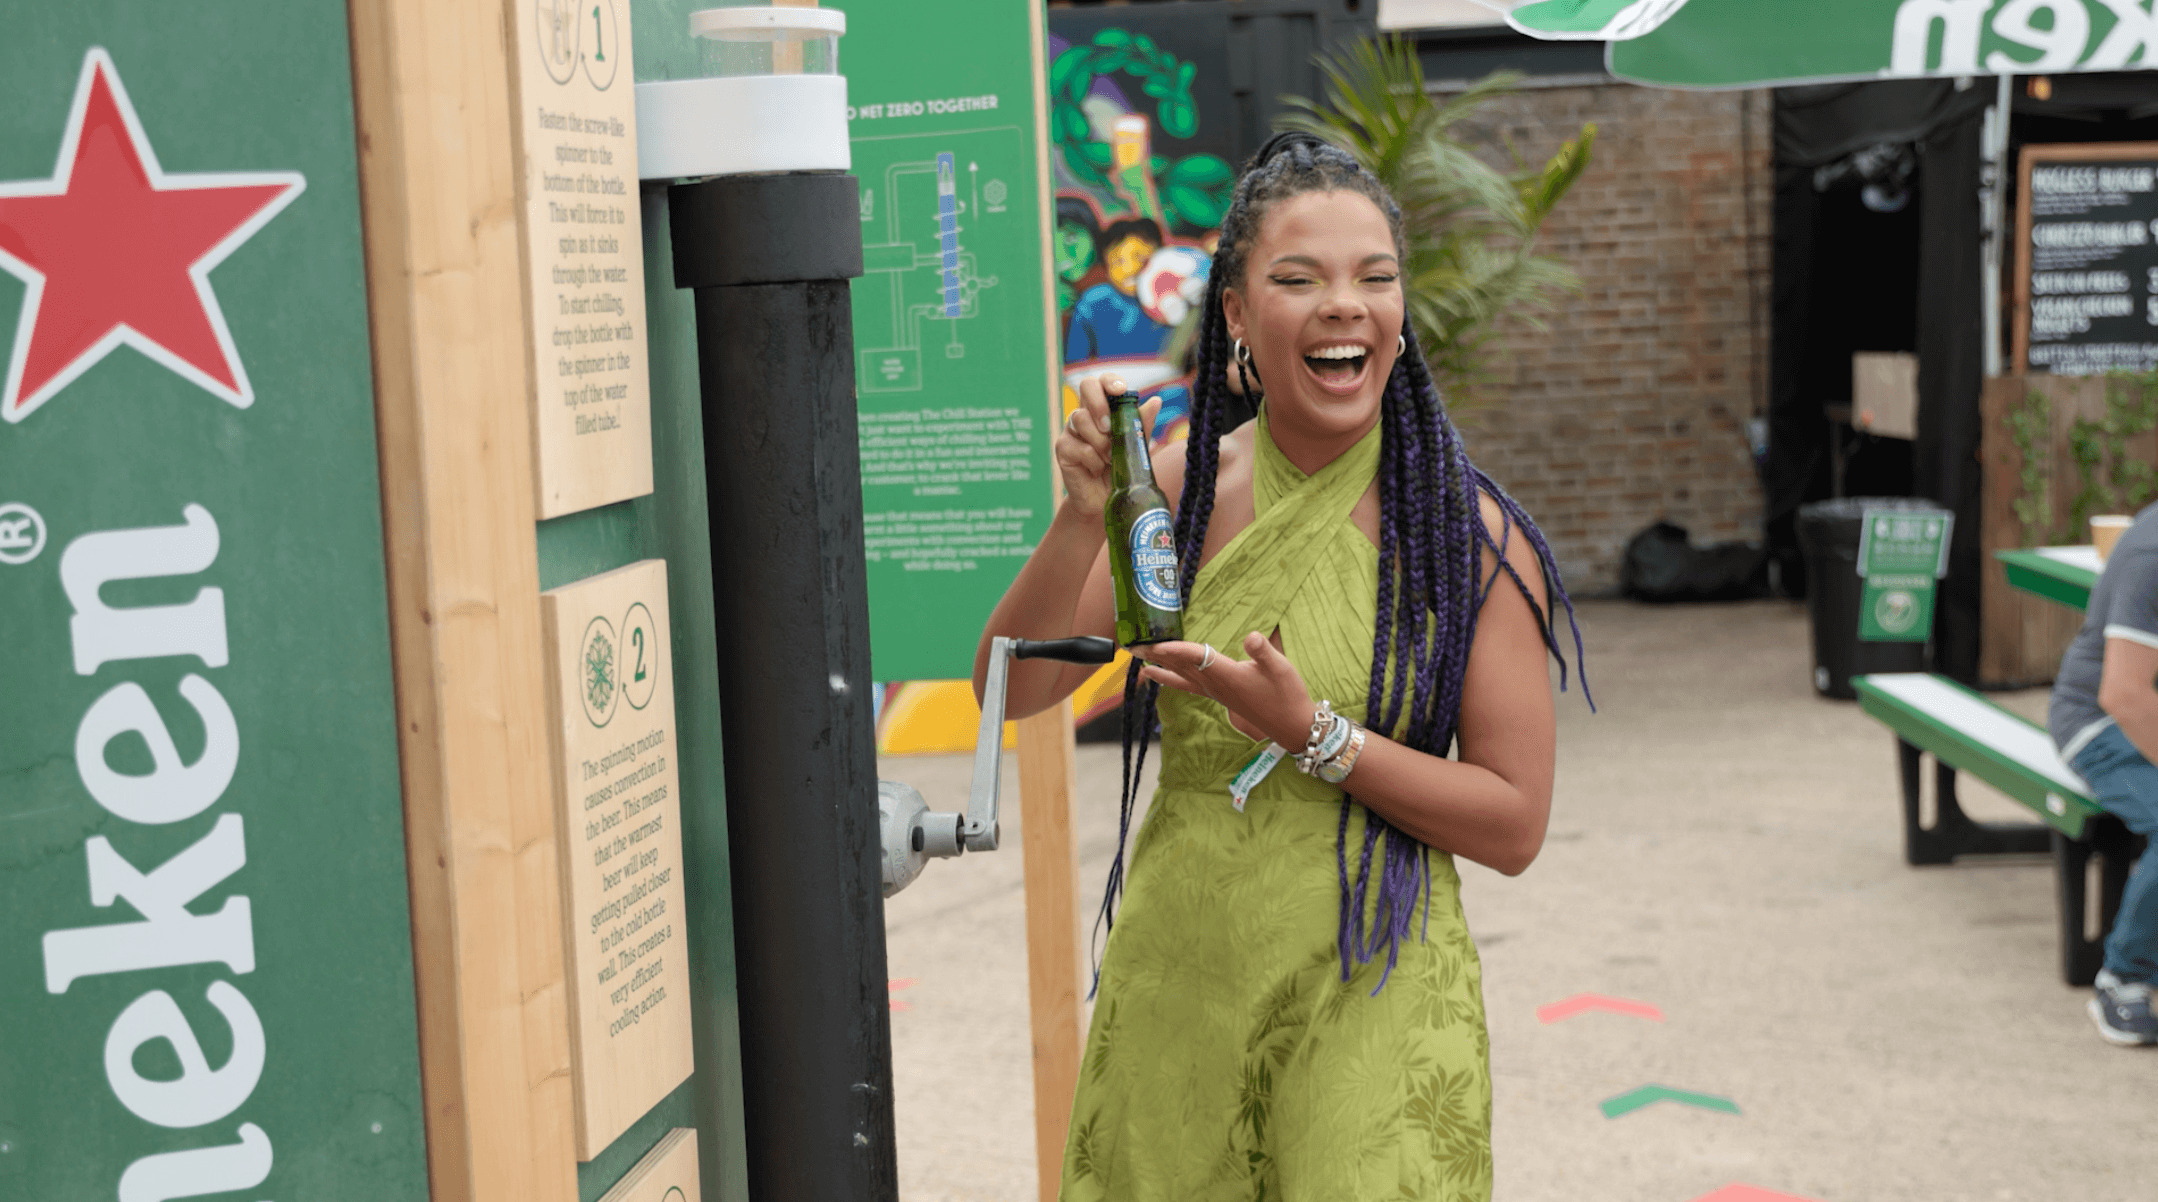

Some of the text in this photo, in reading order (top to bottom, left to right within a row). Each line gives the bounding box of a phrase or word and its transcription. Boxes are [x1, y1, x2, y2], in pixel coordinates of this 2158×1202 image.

[593, 5, 605, 62] 1
[538, 107, 625, 138] Fasten the screw-like
[555, 143, 613, 165] spinner to the
[543, 171, 627, 195] bottom of the bottle.
[549, 201, 625, 225] This will force it to
[559, 234, 620, 258] spin as it sinks
[552, 264, 628, 288] through the water.
[557, 294, 570, 315] To
[571, 295, 591, 314] start
[552, 321, 633, 349] drop the bottle with
[558, 351, 630, 379] the spinner in the
[564, 383, 627, 410] top of the water
[576, 414, 597, 435] filled
[632, 626, 646, 683] 2
[582, 728, 665, 781] The spinning motion
[1241, 752, 1276, 794] Heineken
[584, 754, 666, 811] causes convection in
[585, 783, 667, 841] the beer. This means
[594, 814, 662, 867] that the warmest
[602, 846, 659, 892] beer will keep
[591, 867, 671, 935] getting pulled closer
[600, 897, 666, 954] to the cold bottle
[597, 924, 672, 986] wall. This creates a
[610, 956, 663, 1006] very efficient
[609, 985, 667, 1038] cooling action.
